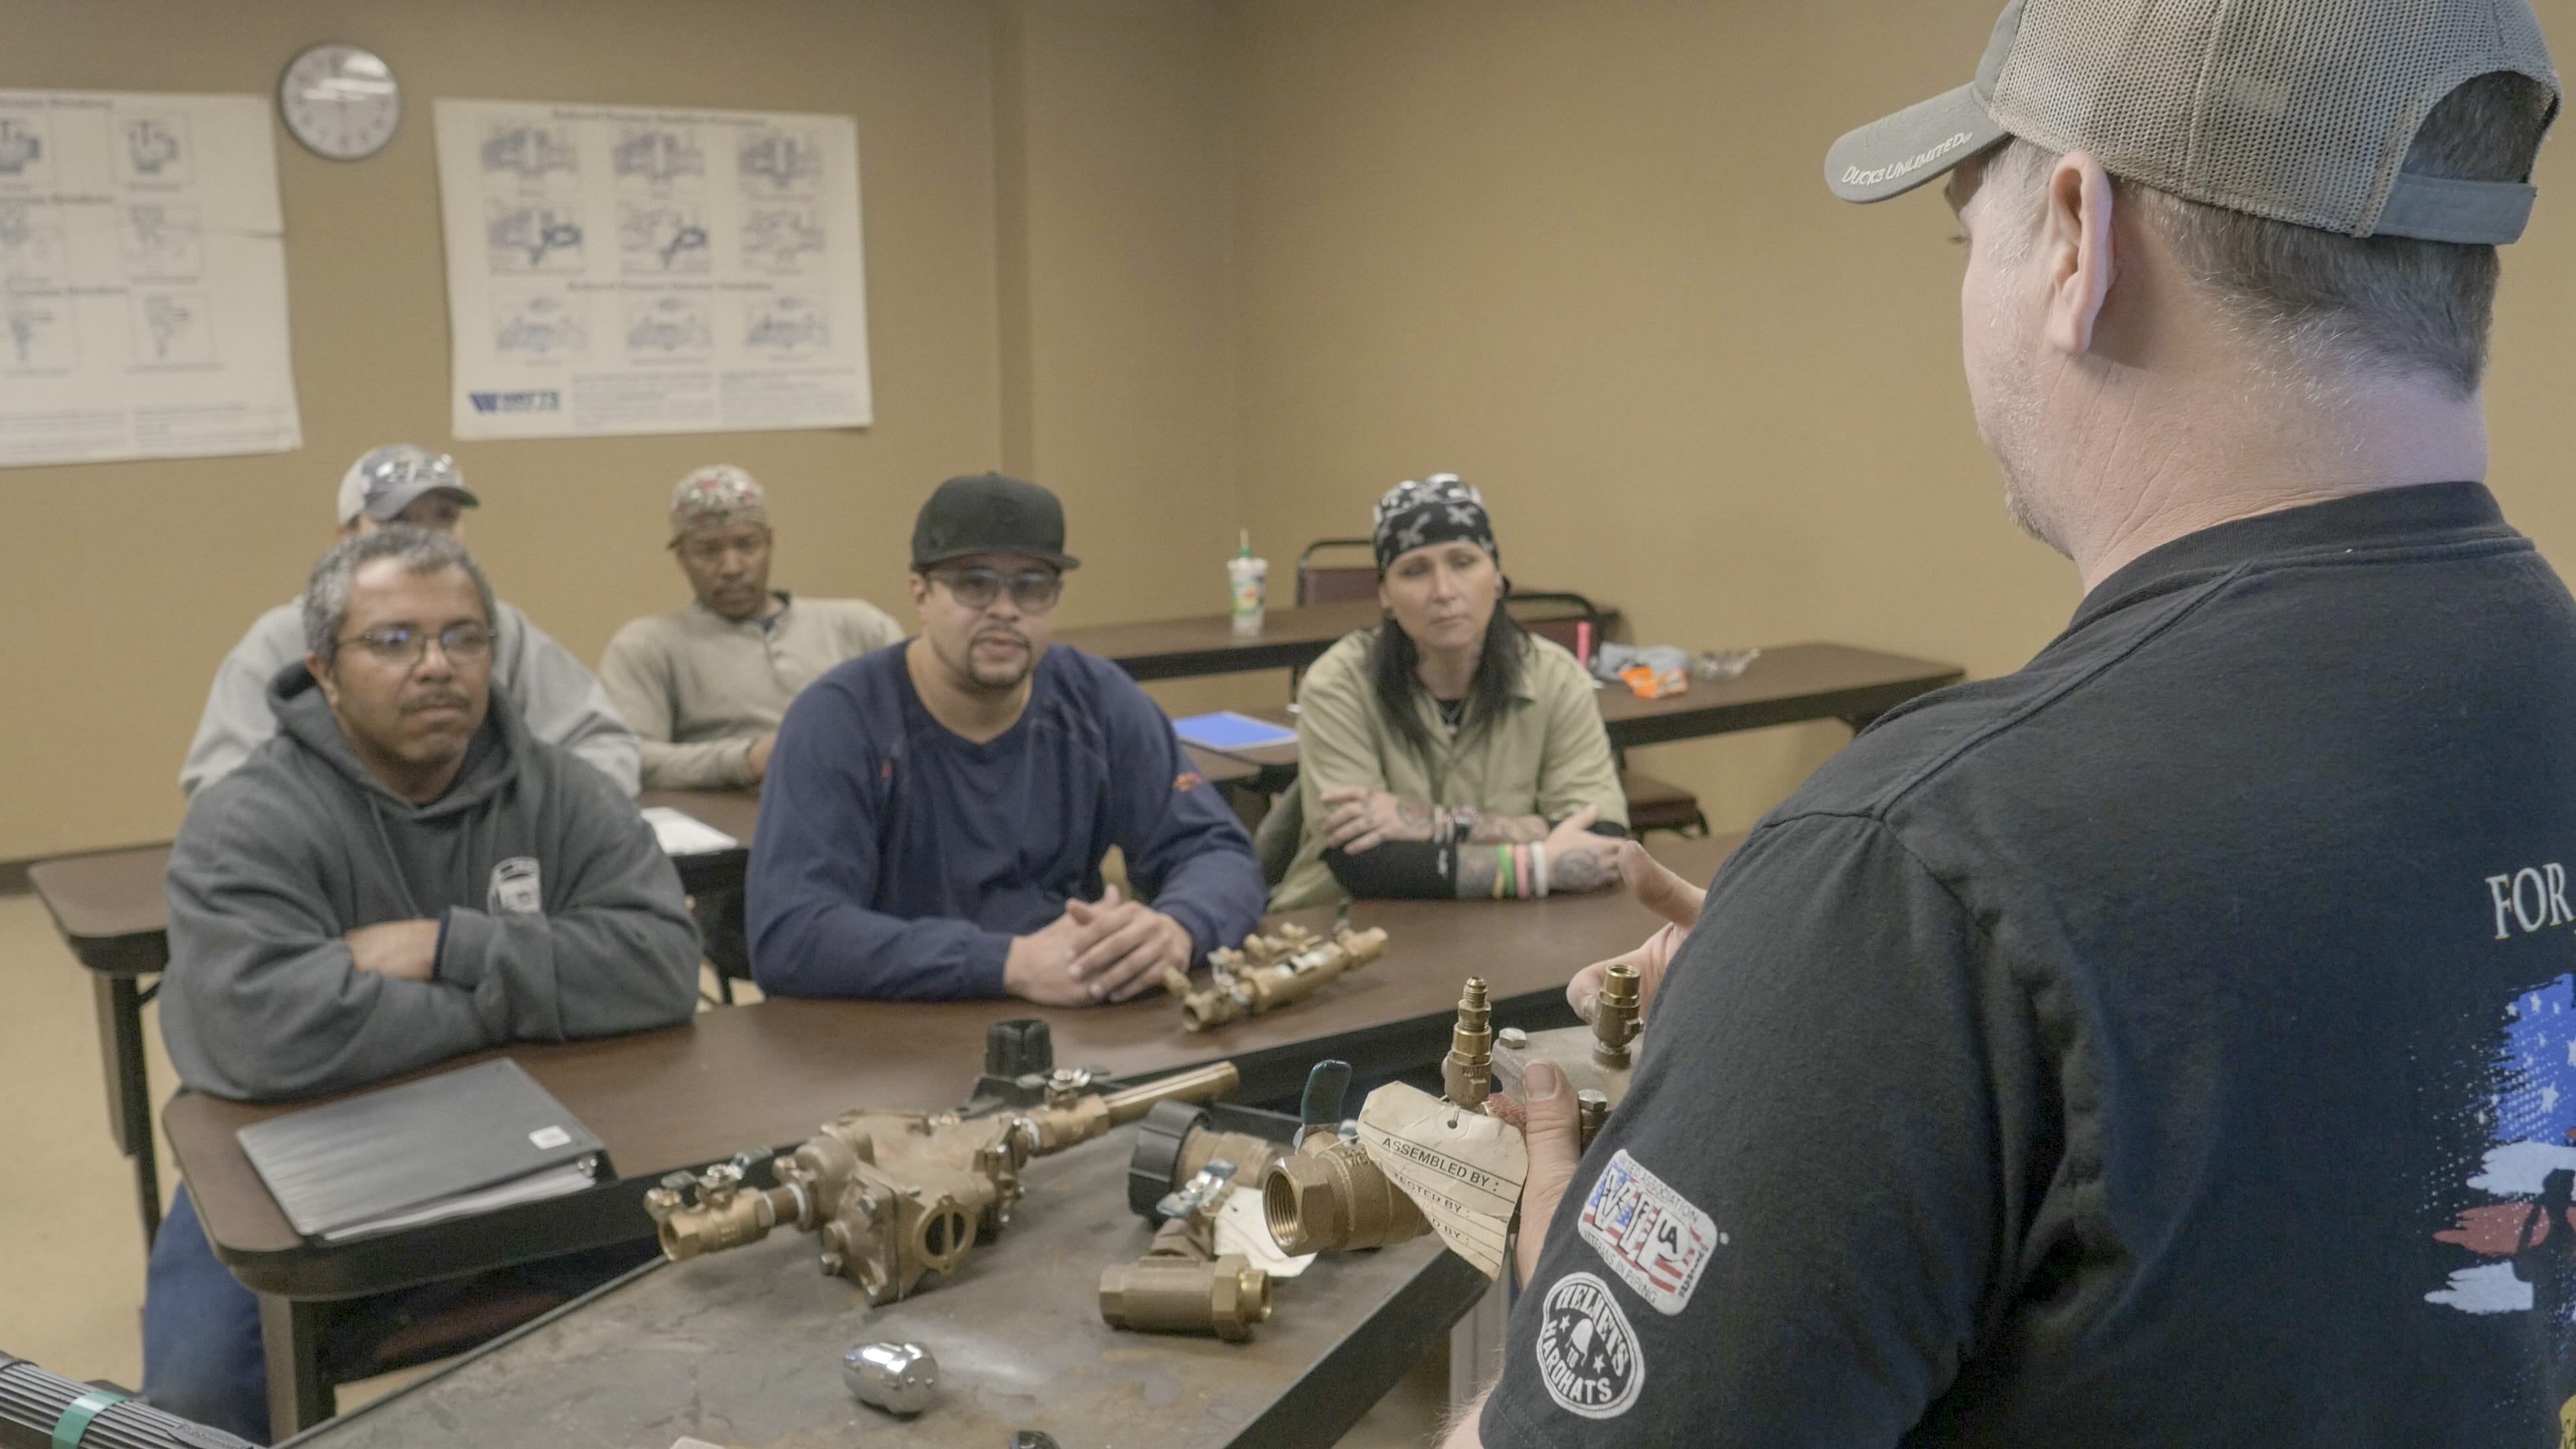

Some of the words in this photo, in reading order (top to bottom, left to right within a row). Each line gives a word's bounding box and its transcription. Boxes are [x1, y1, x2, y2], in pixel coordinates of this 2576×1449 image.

[1842, 166, 1886, 185] DUCKS
[2484, 862, 2576, 940] FOR
[1383, 1138, 1467, 1178] ASSEMBLED
[1642, 1174, 1699, 1223] ASSOCIATION
[1625, 1269, 1658, 1303] PIPING
[1543, 1320, 1613, 1403] HARDHATS
[1566, 1347, 1579, 1368] TO
